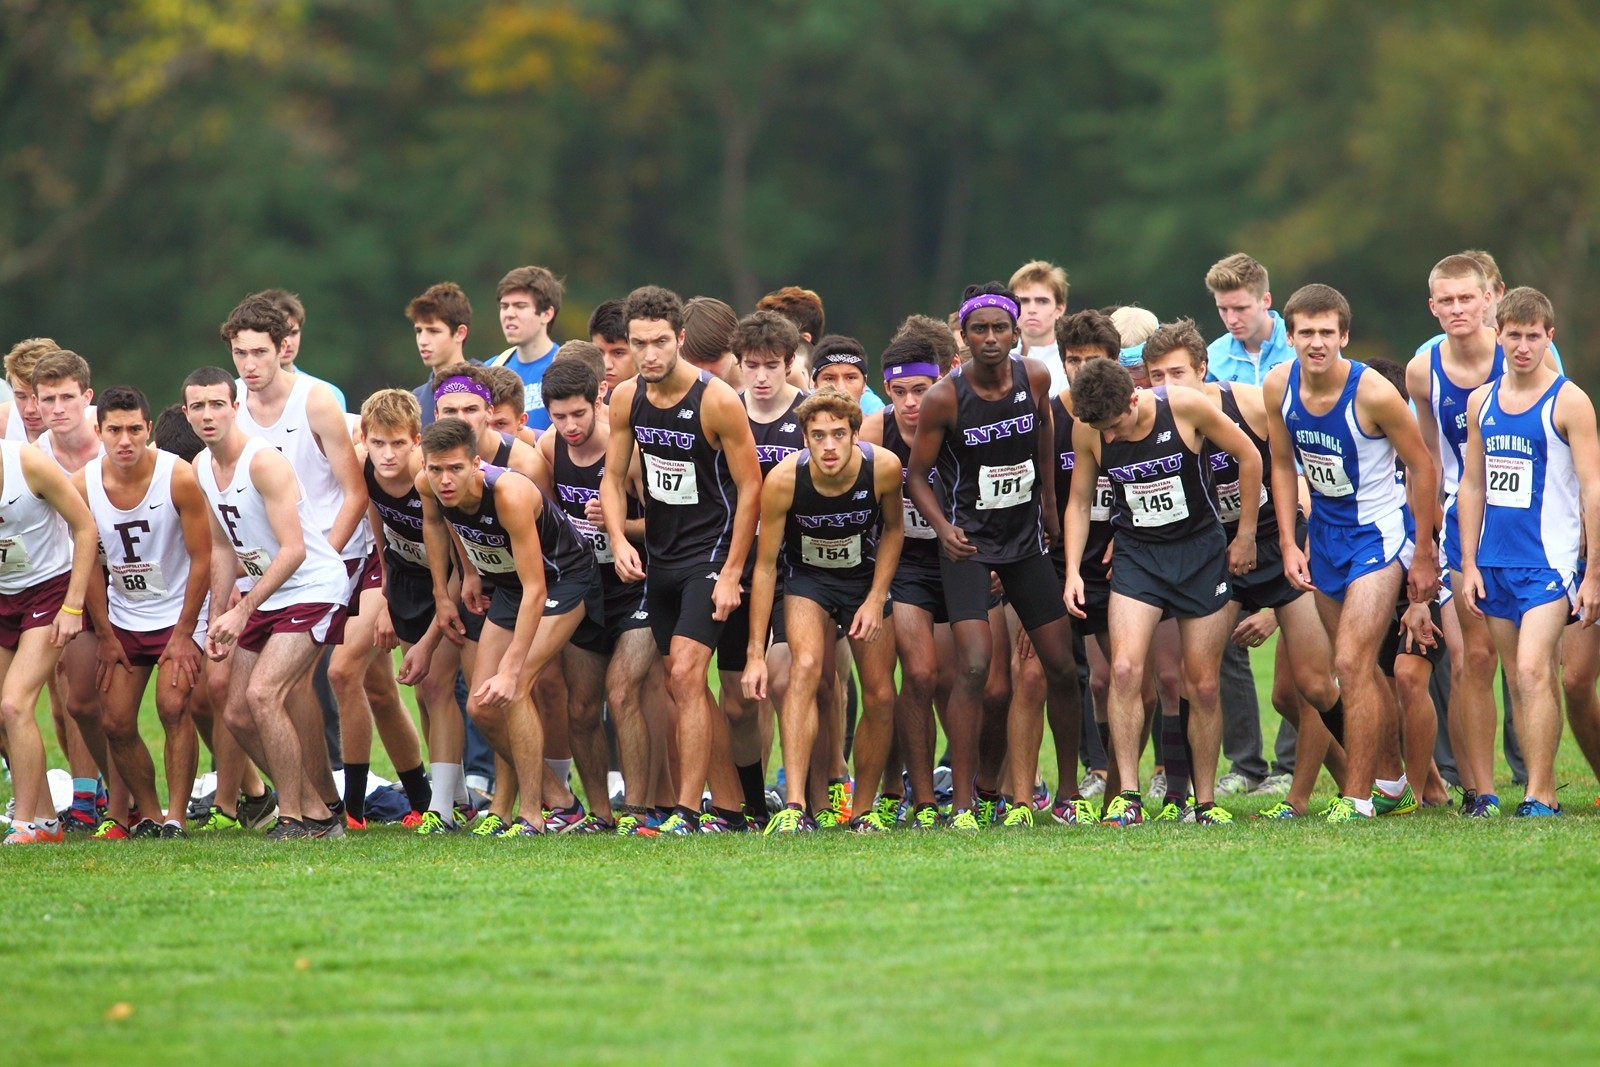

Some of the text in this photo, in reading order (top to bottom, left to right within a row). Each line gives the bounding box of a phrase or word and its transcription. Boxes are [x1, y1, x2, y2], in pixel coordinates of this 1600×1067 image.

[677, 409, 694, 419] NB
[779, 422, 796, 432] NB
[964, 413, 1033, 445] NYU
[1156, 430, 1171, 444] NB
[635, 426, 695, 450] NYU
[1296, 430, 1342, 454] SETON HALL
[1486, 435, 1532, 456] SETON HALL
[756, 445, 798, 462] YU
[1108, 452, 1183, 482] NYU
[1308, 464, 1336, 485] 214
[656, 471, 682, 491] 167
[992, 477, 1021, 497] 151
[1133, 481, 1171, 490] METROPOLITAN
[1490, 471, 1520, 492] 220
[557, 483, 600, 504] NY
[1139, 492, 1173, 513] 145
[218, 504, 243, 546] F
[795, 509, 872, 528] NYU
[114, 520, 150, 563] F
[452, 523, 504, 546] NYU
[470, 549, 502, 564] 160
[816, 547, 850, 560] 154
[243, 560, 264, 576] 68
[122, 575, 146, 590] 58
